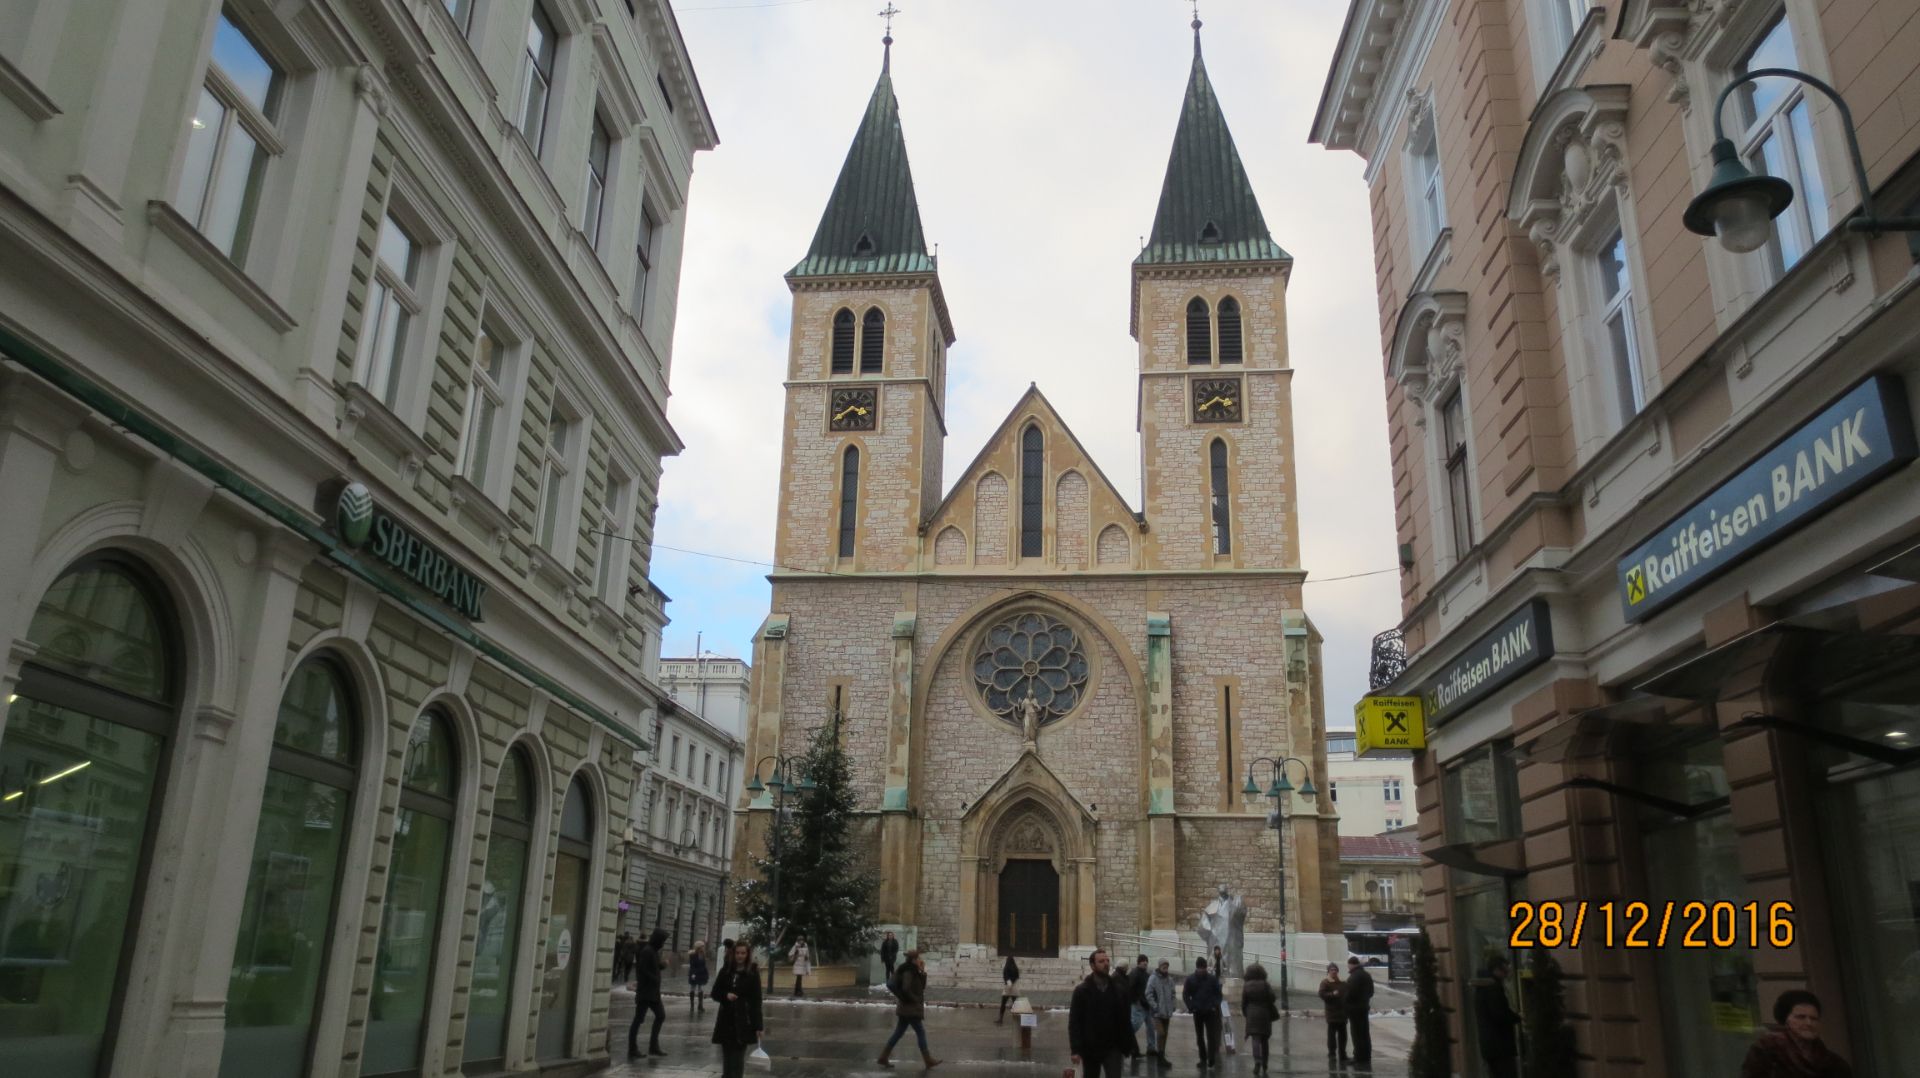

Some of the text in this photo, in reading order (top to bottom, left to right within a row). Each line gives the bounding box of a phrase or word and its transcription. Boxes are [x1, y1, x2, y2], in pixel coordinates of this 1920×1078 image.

[1644, 407, 1872, 594] Raiffeisen BANK
[372, 514, 488, 619] SBERBANK
[1372, 699, 1415, 707] Raiffeisen
[1437, 619, 1532, 710] Raiffeisen BANK
[1384, 737, 1409, 745] BANK
